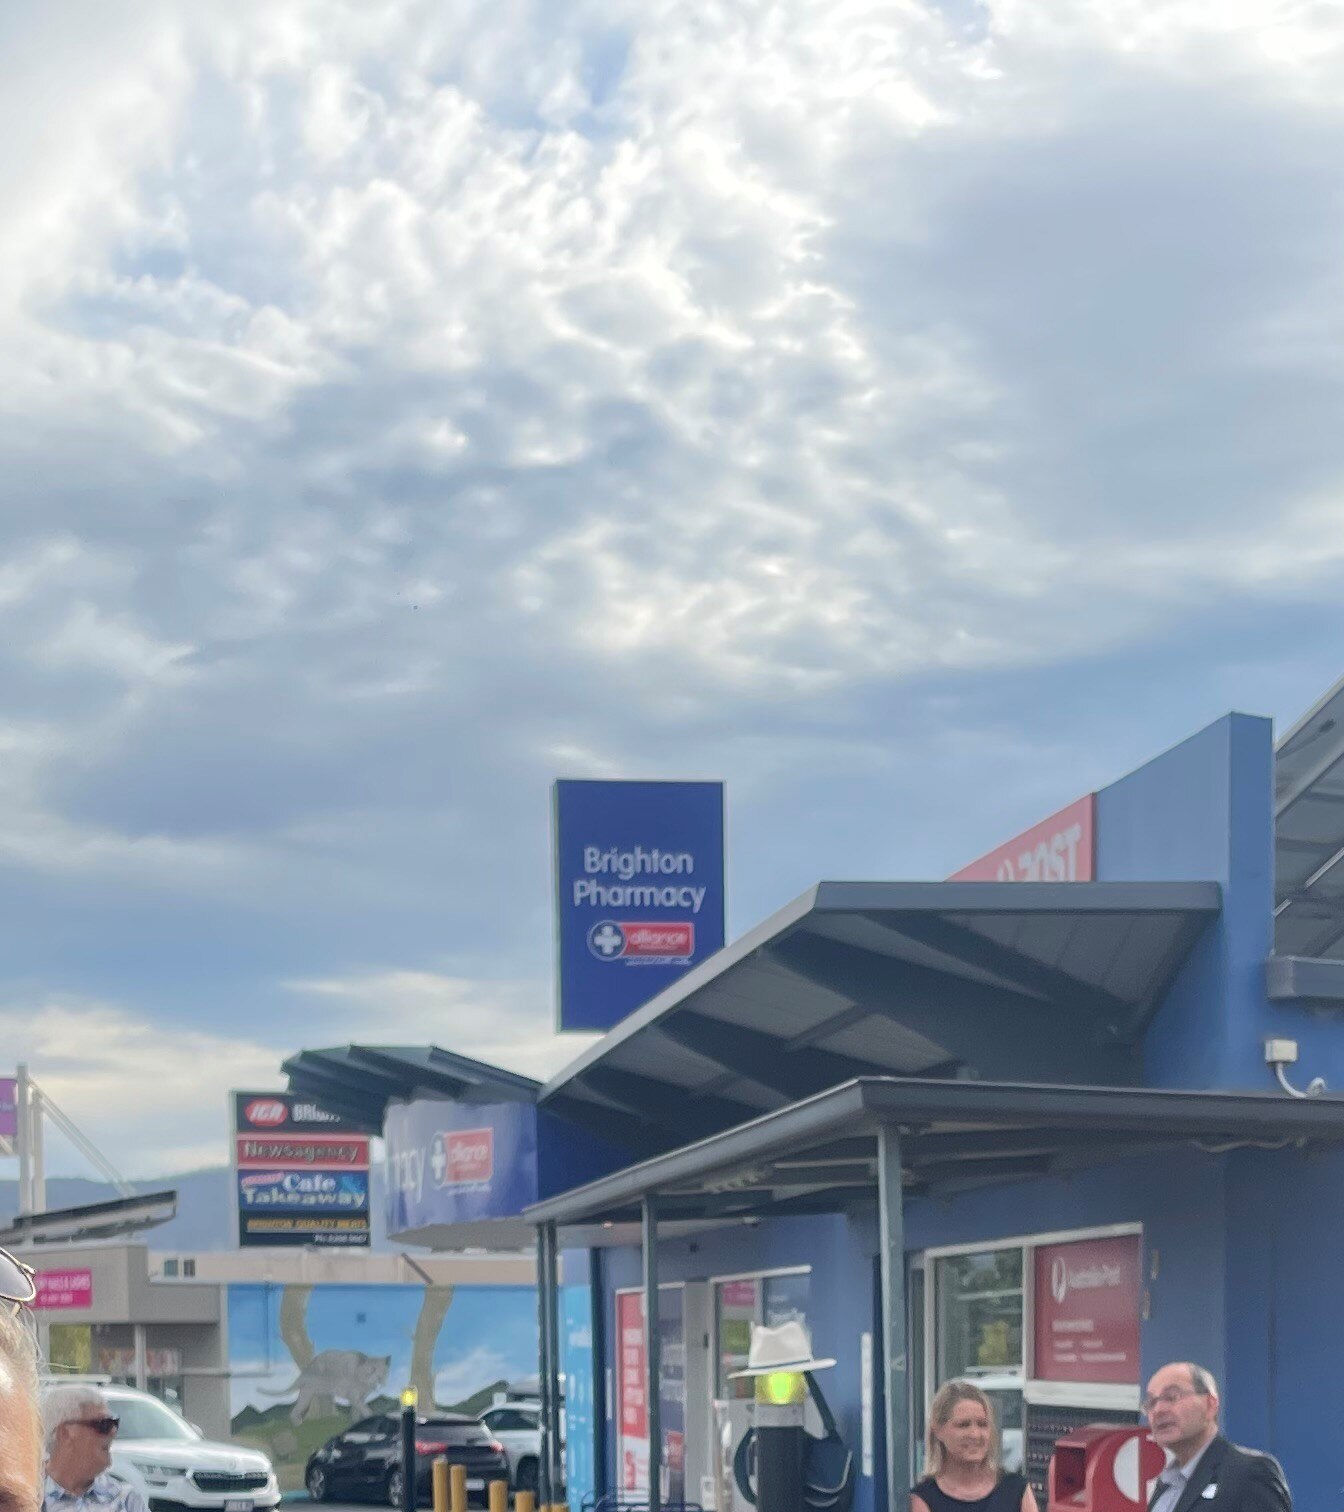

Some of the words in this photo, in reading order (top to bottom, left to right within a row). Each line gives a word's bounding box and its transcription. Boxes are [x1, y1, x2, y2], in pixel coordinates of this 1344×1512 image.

[583, 845, 694, 880] Brighton
[573, 879, 706, 914] Pharmacy
[249, 1102, 285, 1122] IGA
[244, 1142, 359, 1163] Newsagency
[283, 1173, 336, 1192] Cafe
[241, 1187, 365, 1208] Takeaway
